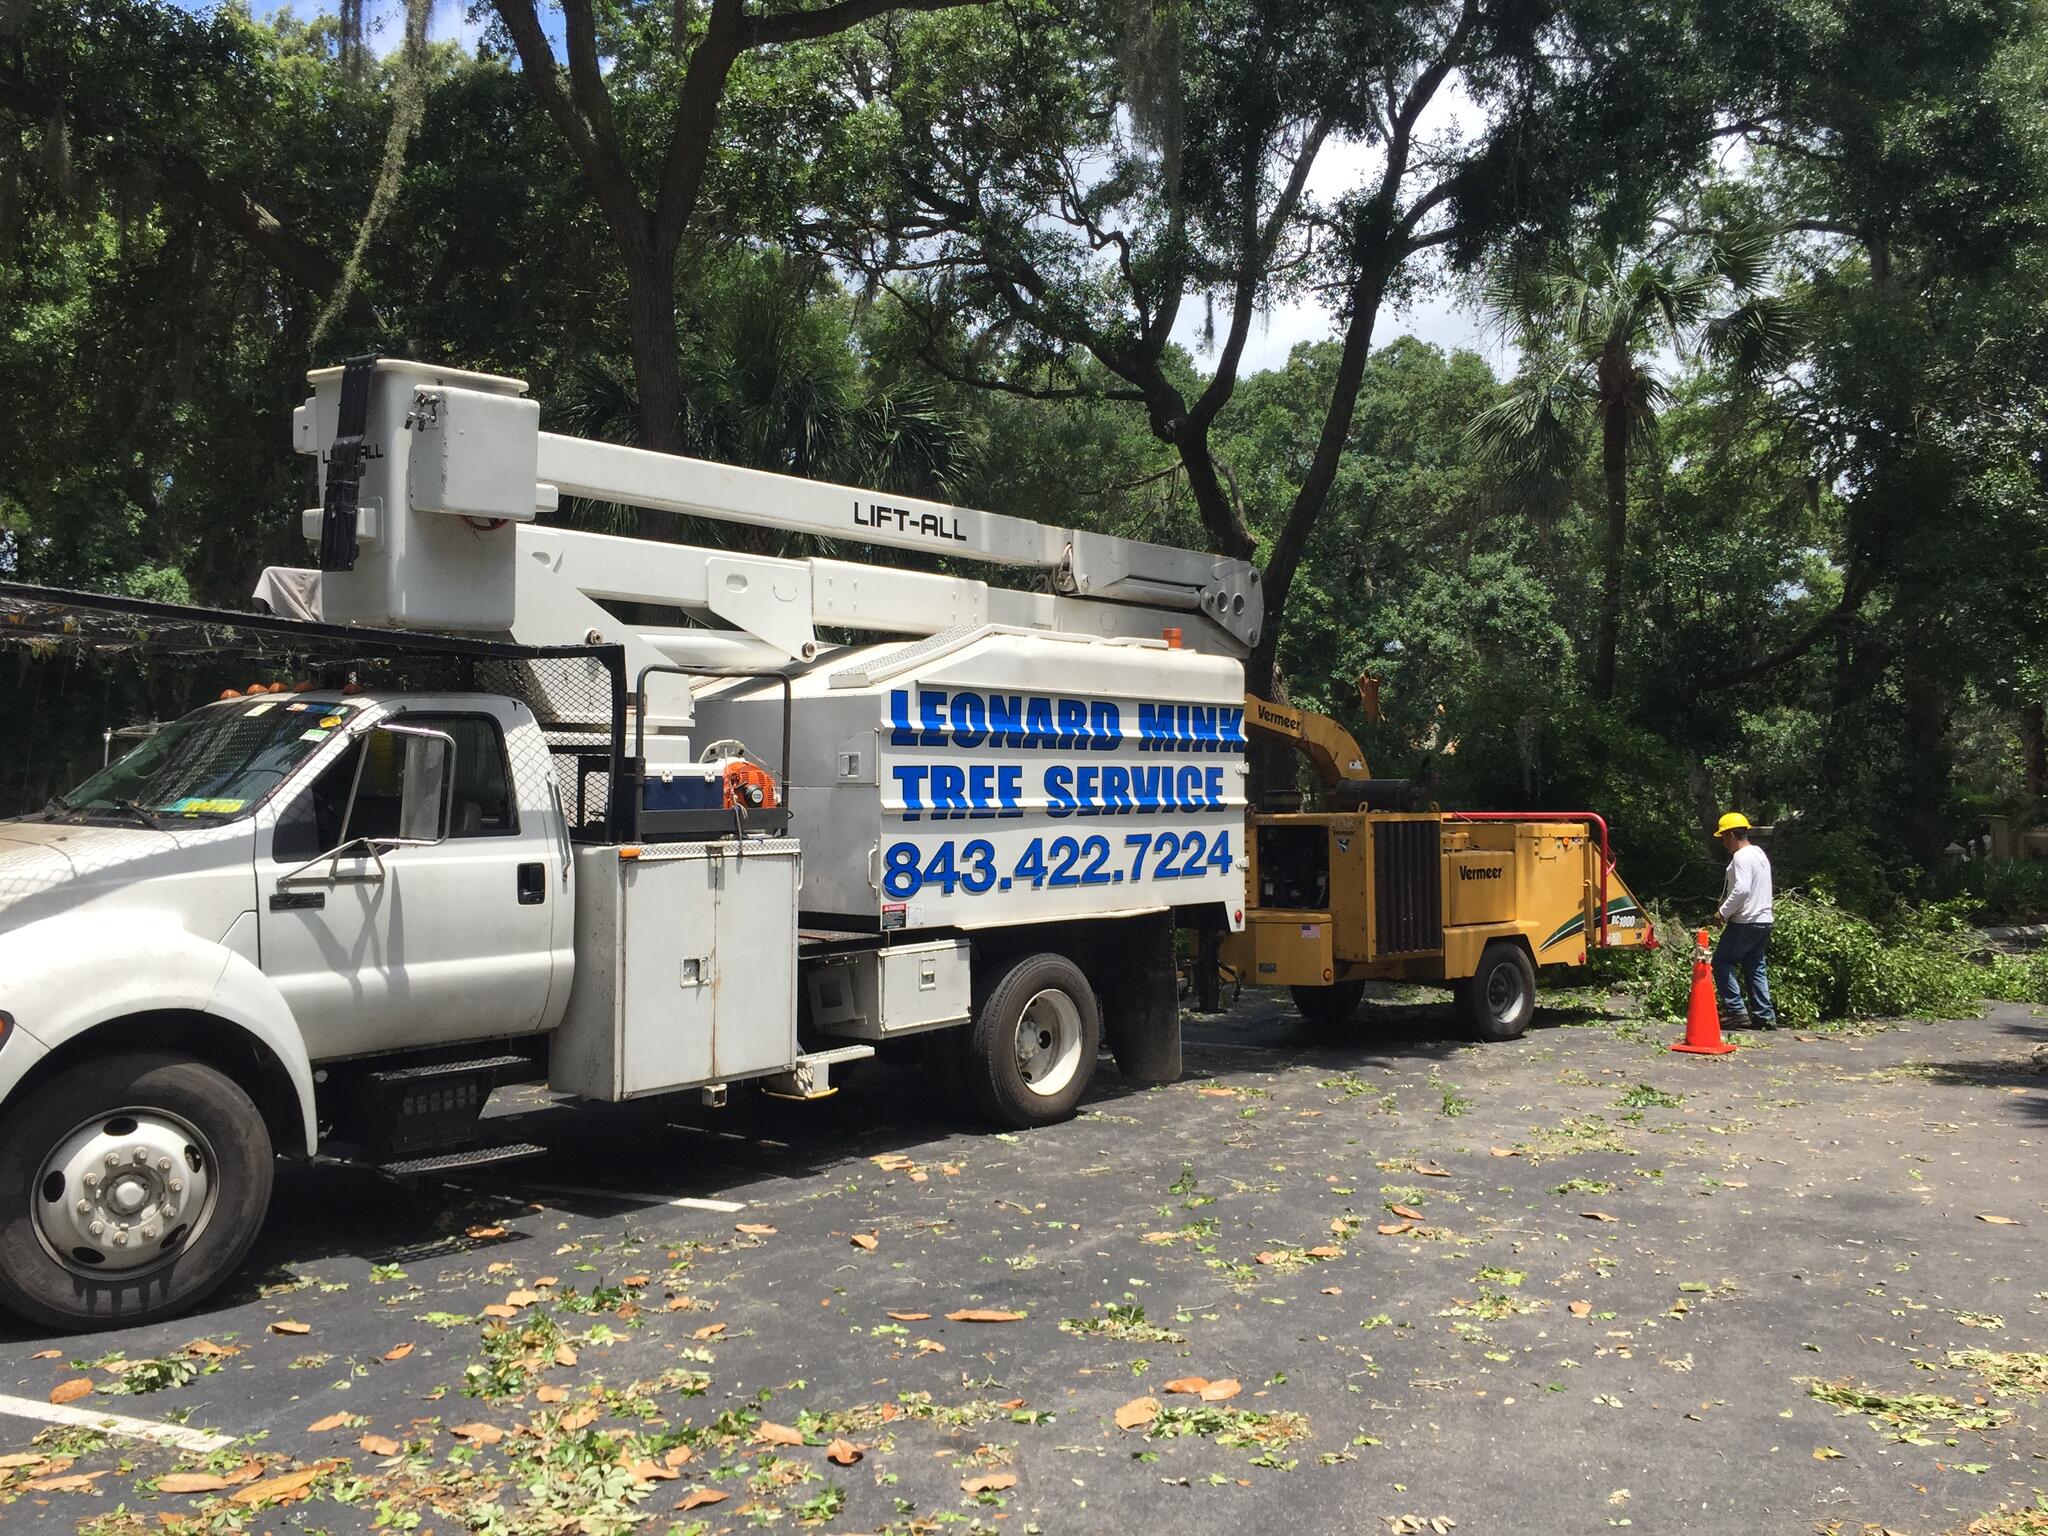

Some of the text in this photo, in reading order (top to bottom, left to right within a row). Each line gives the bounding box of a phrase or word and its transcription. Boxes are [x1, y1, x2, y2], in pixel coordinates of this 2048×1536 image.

[854, 501, 967, 541] LIFT-ALL
[890, 689, 1247, 753] LEONARD MINK
[1258, 704, 1301, 732] Vermeer
[892, 765, 1226, 822] TREE SERVICE
[881, 829, 1234, 899] 843.422.7224
[1459, 864, 1503, 881] Vermeer
